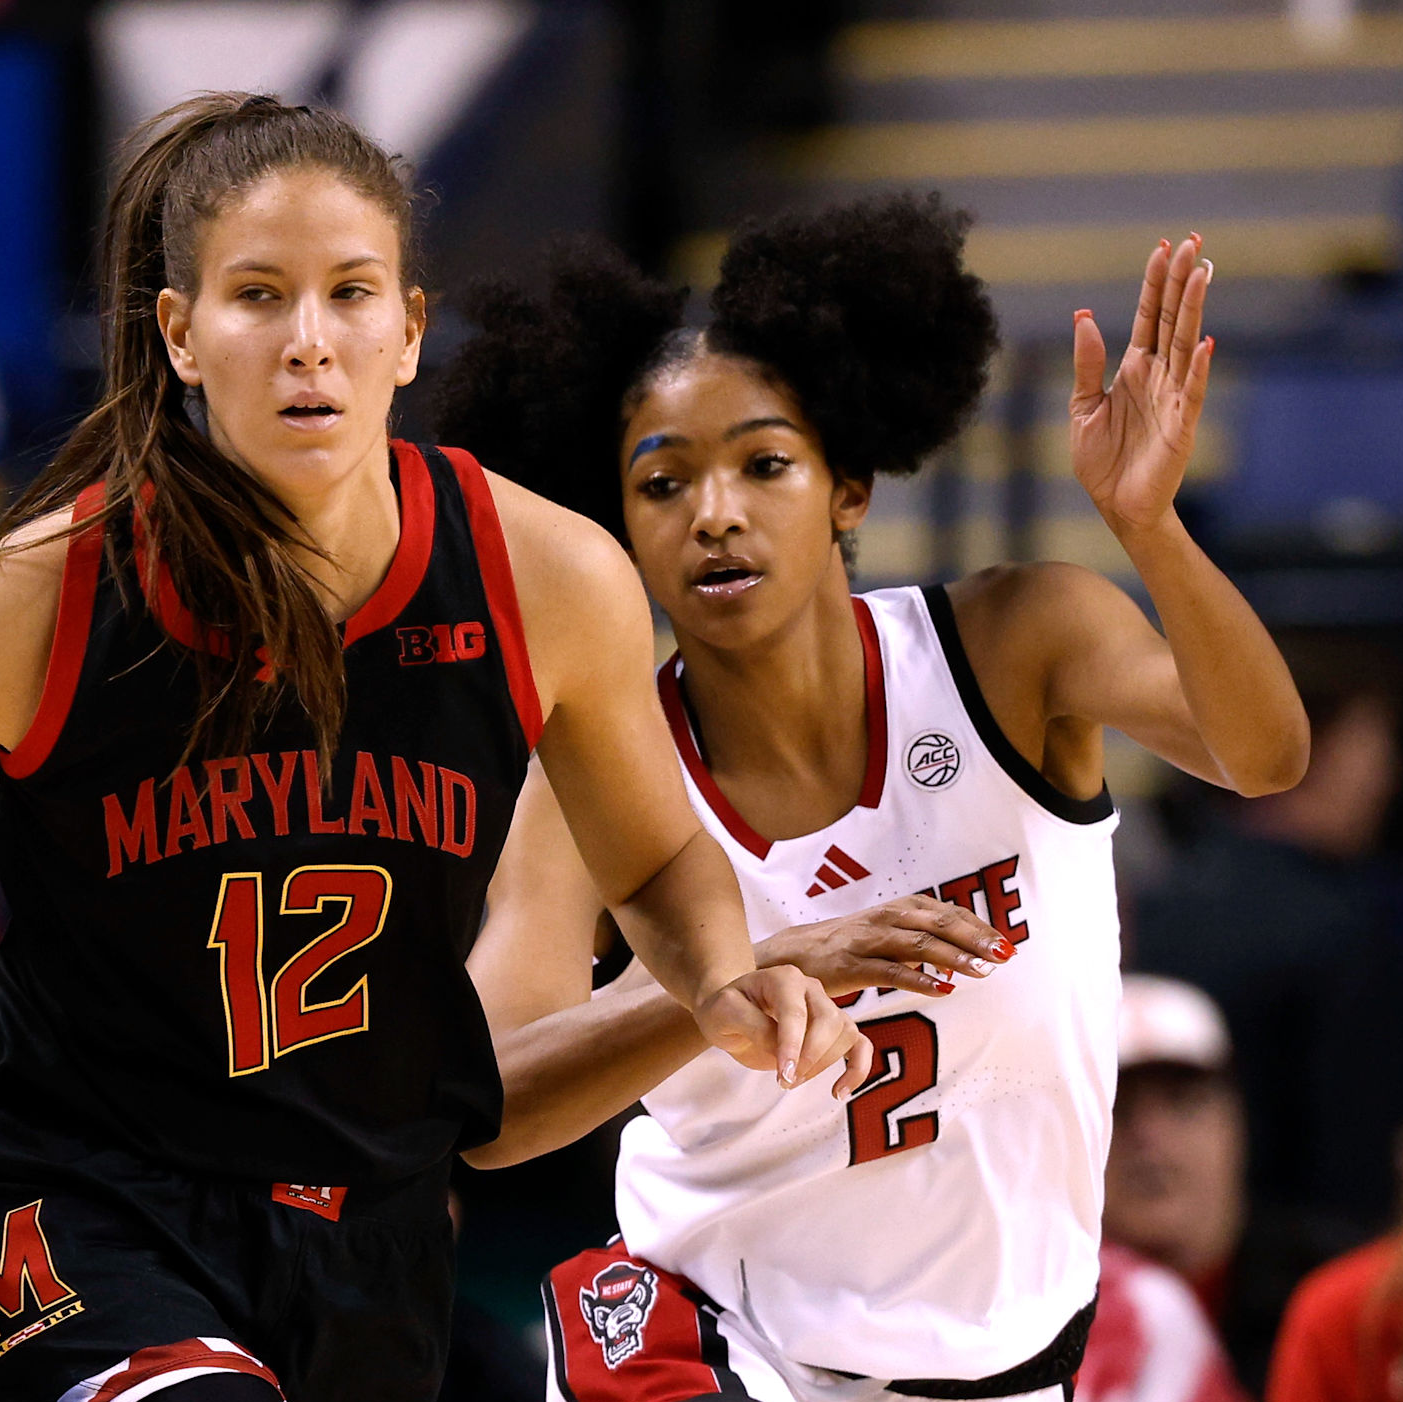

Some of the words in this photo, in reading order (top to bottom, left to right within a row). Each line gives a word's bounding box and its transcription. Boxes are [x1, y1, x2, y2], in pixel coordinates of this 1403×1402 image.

[102, 750, 477, 878] MARYLAND
[915, 745, 955, 768] ACC
[207, 865, 392, 1077] 12
[846, 1010, 939, 1168] 2
[602, 1285, 612, 1296] NC
[612, 1279, 633, 1296] STATE
